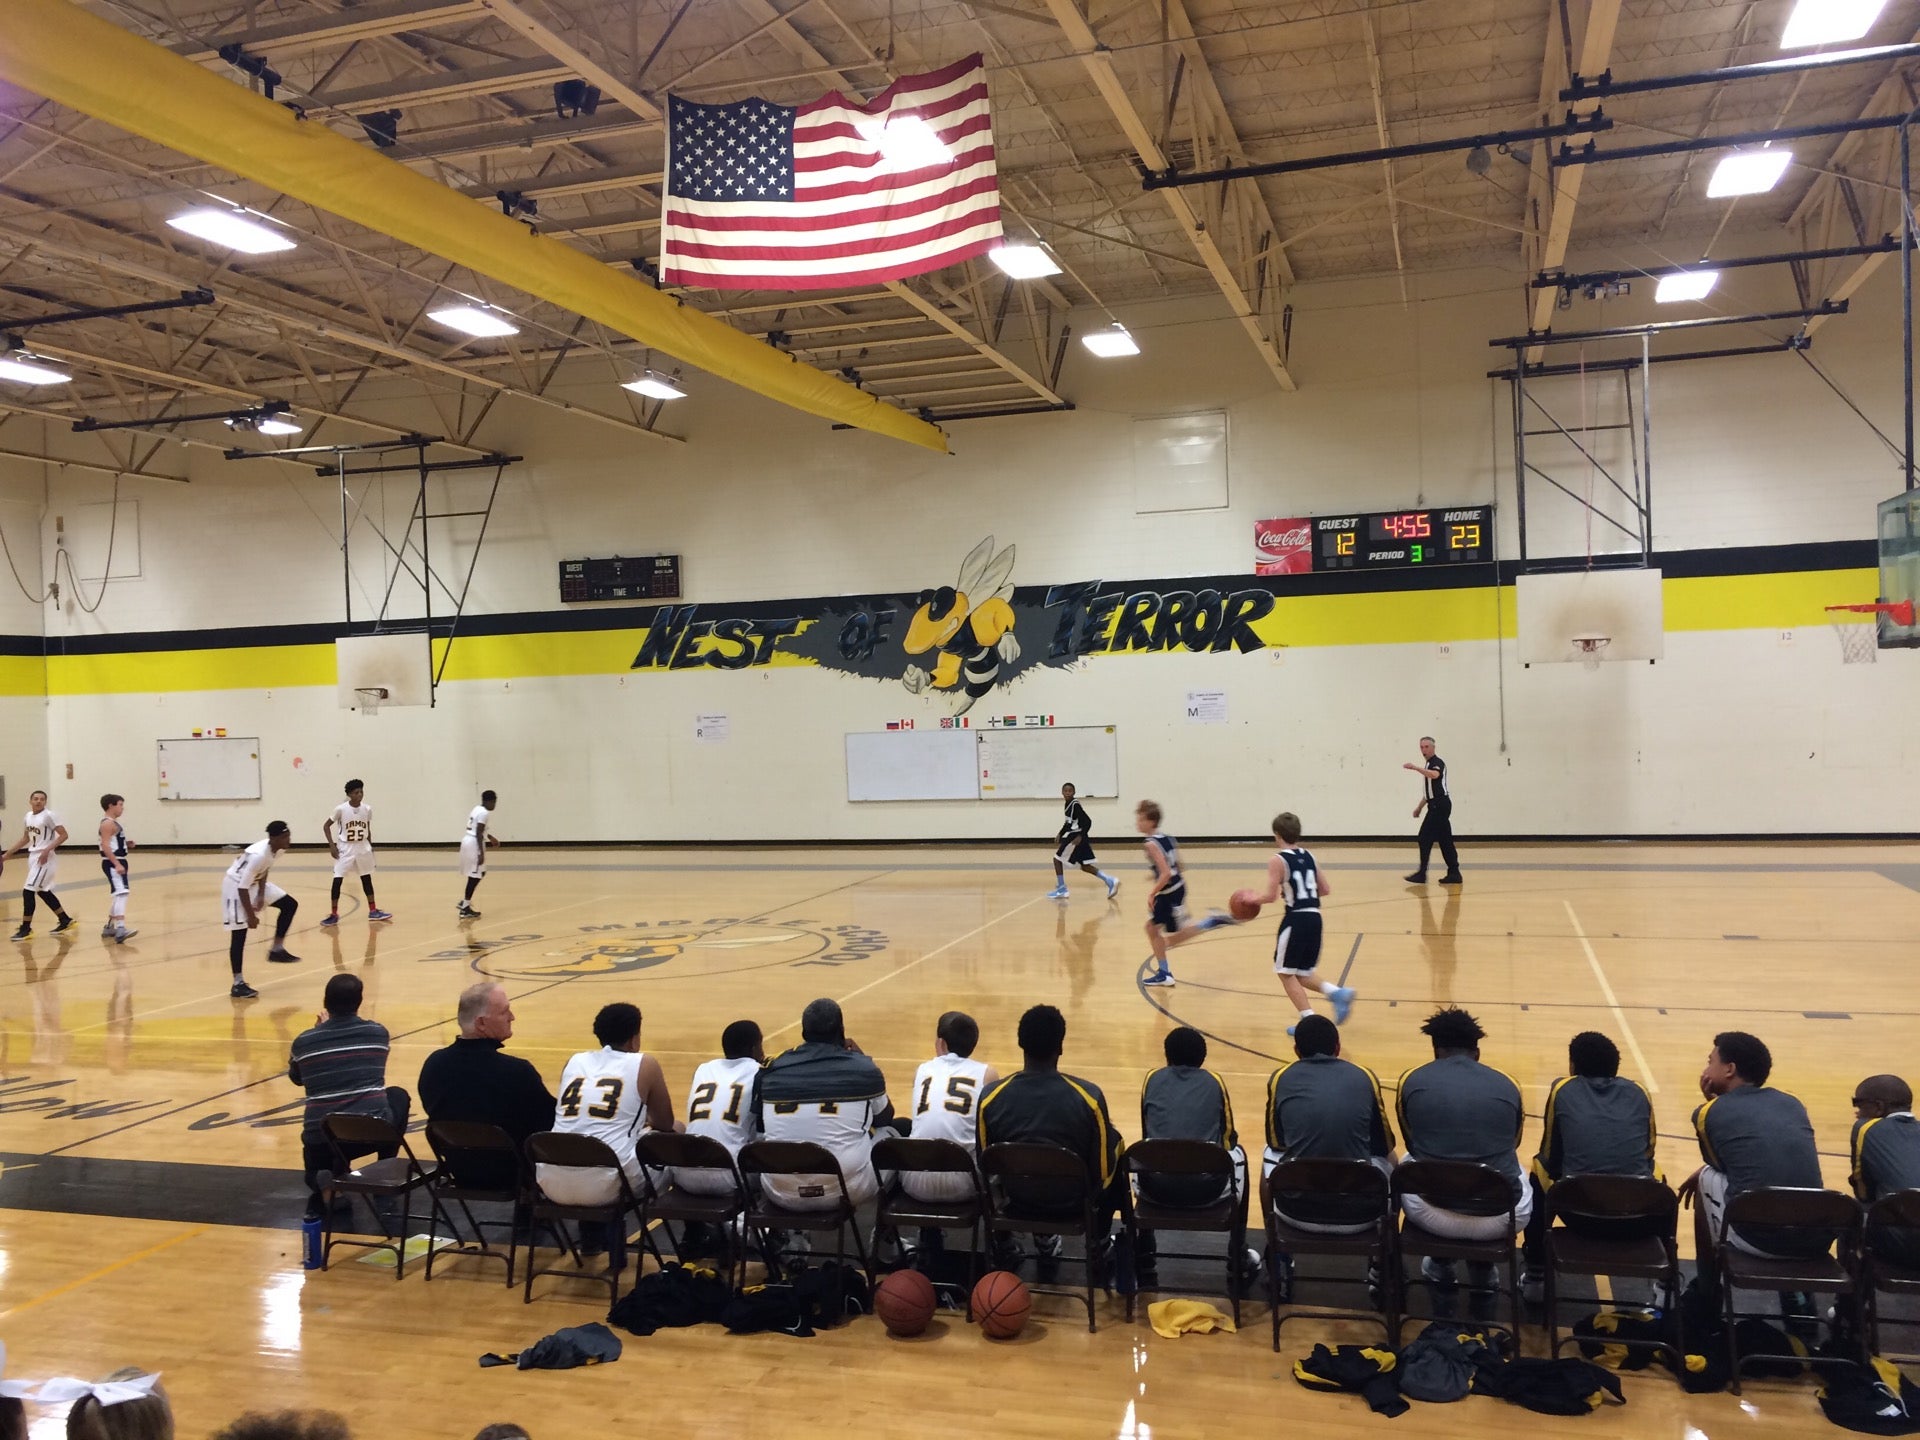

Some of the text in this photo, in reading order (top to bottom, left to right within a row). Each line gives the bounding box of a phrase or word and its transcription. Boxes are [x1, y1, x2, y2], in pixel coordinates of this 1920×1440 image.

[1444, 510, 1482, 522] HOME
[1318, 518, 1359, 530] GUEST
[1383, 514, 1431, 538] 4:55
[1451, 525, 1480, 548] 23
[1337, 532, 1355, 555] 12
[1368, 550, 1405, 560] PERIOD
[1411, 545, 1422, 562] 3
[613, 588, 628, 596] TIME
[630, 578, 1276, 670] NEST OF TERROR
[1782, 631, 1793, 641] 12
[1440, 645, 1450, 654] 10
[1273, 651, 1280, 661] 9
[1081, 660, 1088, 669] 8
[763, 672, 769, 681] 6
[923, 697, 929, 705] 7
[1188, 707, 1199, 717] M
[697, 728, 703, 738] R
[345, 820, 367, 830] IRMO
[347, 829, 364, 842] 25
[1292, 869, 1318, 899] 14
[577, 917, 822, 932] MIDDLE
[789, 924, 891, 968] SCHOOL
[560, 1077, 624, 1120] 43
[916, 1077, 977, 1116] 15
[689, 1082, 746, 1124] 21
